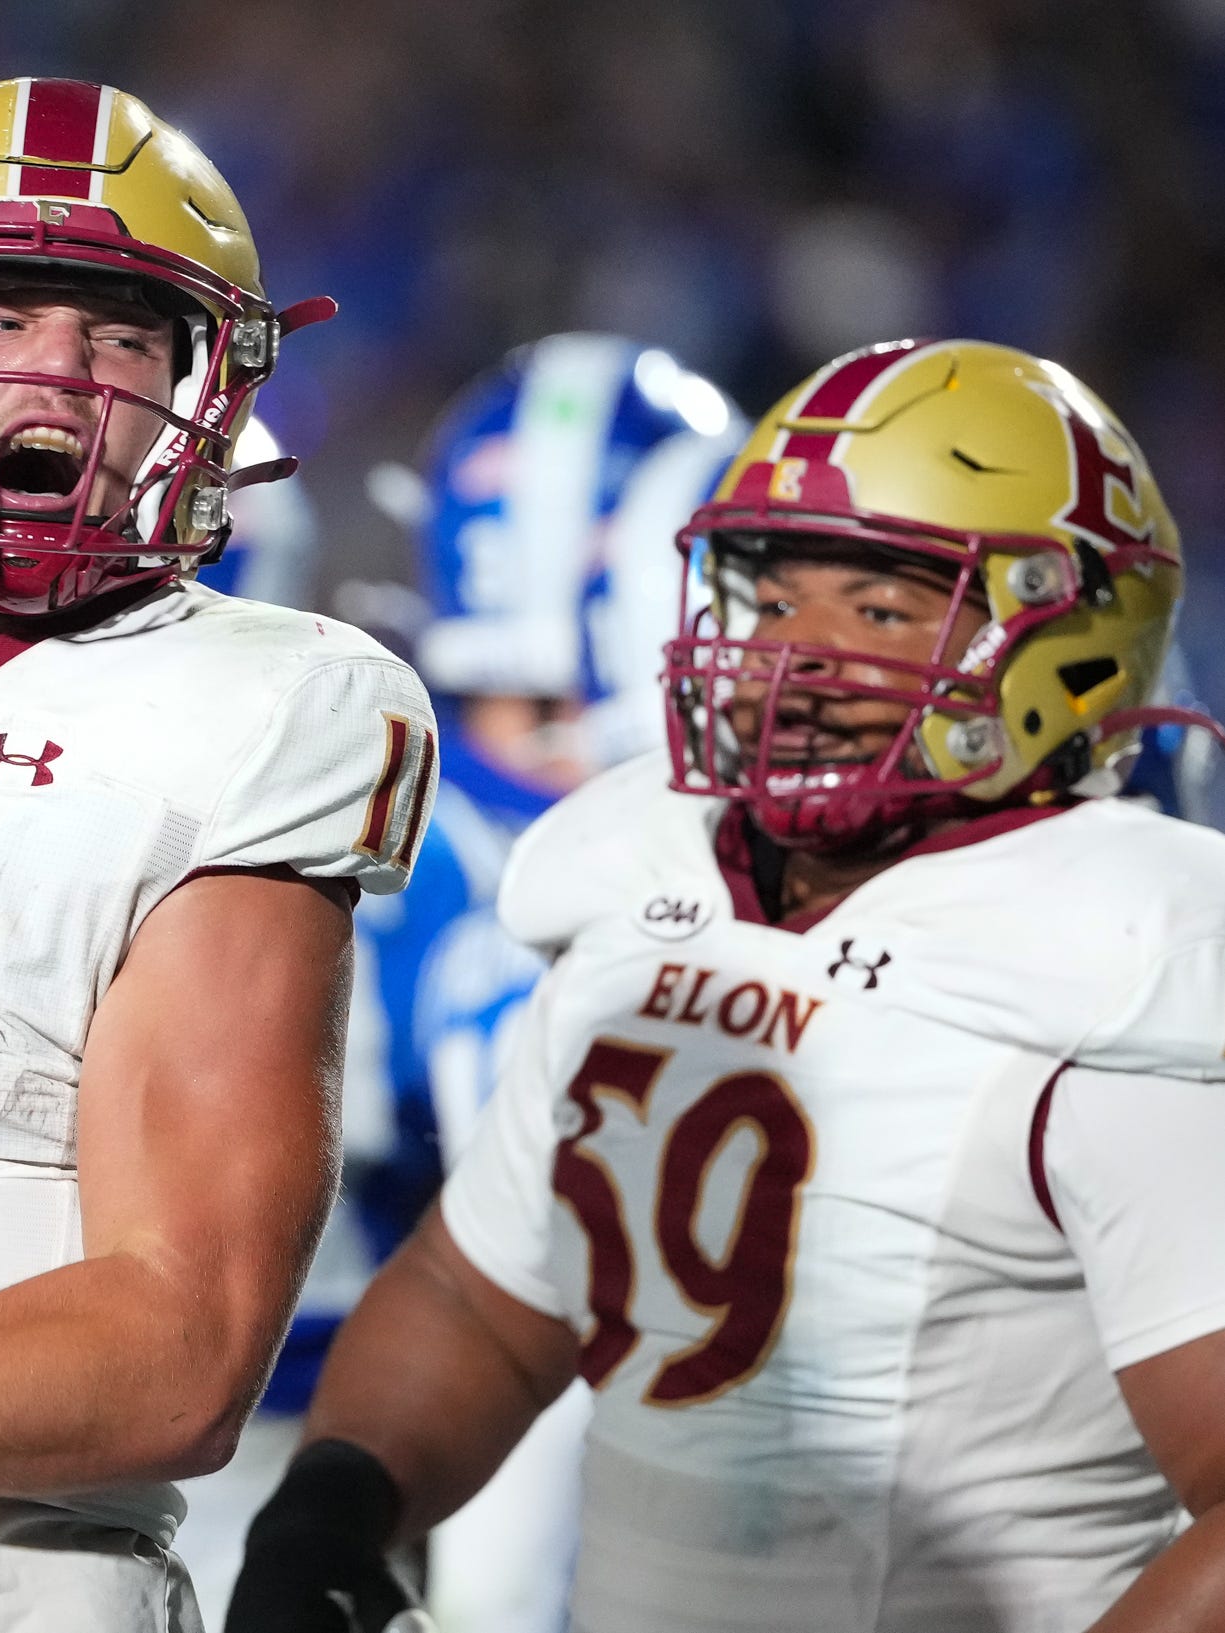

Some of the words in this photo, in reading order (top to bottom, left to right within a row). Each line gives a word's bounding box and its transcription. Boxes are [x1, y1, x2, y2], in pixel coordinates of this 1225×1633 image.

[350, 709, 436, 874] 11
[644, 896, 700, 925] CAA
[635, 961, 825, 1057] ELON
[553, 1035, 817, 1410] 59
